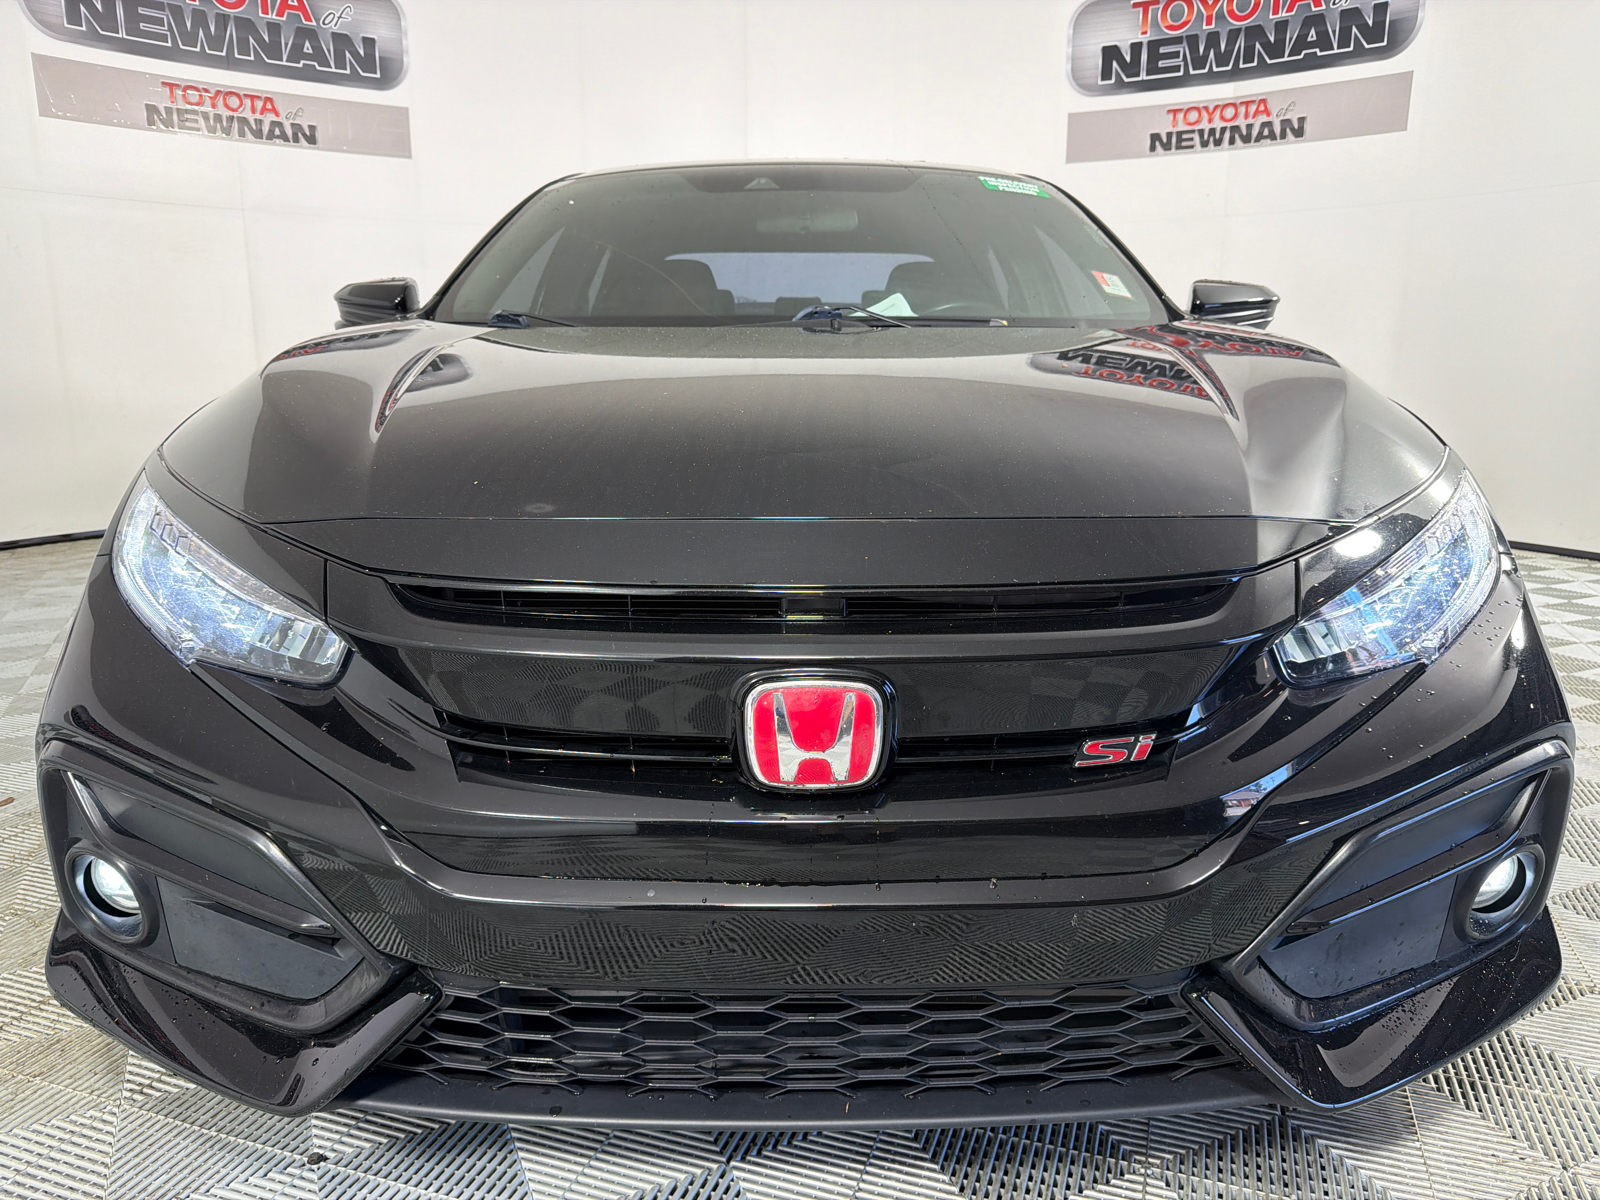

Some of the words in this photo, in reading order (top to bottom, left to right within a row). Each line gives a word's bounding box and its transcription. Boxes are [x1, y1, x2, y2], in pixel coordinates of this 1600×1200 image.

[319, 4, 354, 29] of
[62, 0, 381, 78] NEWNAN
[1099, 1, 1390, 84] NEWNAN
[161, 80, 281, 118] TOYOTA
[284, 107, 304, 121] of
[1166, 98, 1272, 129] TOYOTA
[1275, 100, 1296, 119] of
[144, 102, 318, 146] NEWNAN
[1148, 116, 1308, 153] NEWNAN
[1074, 732, 1157, 769] Si
